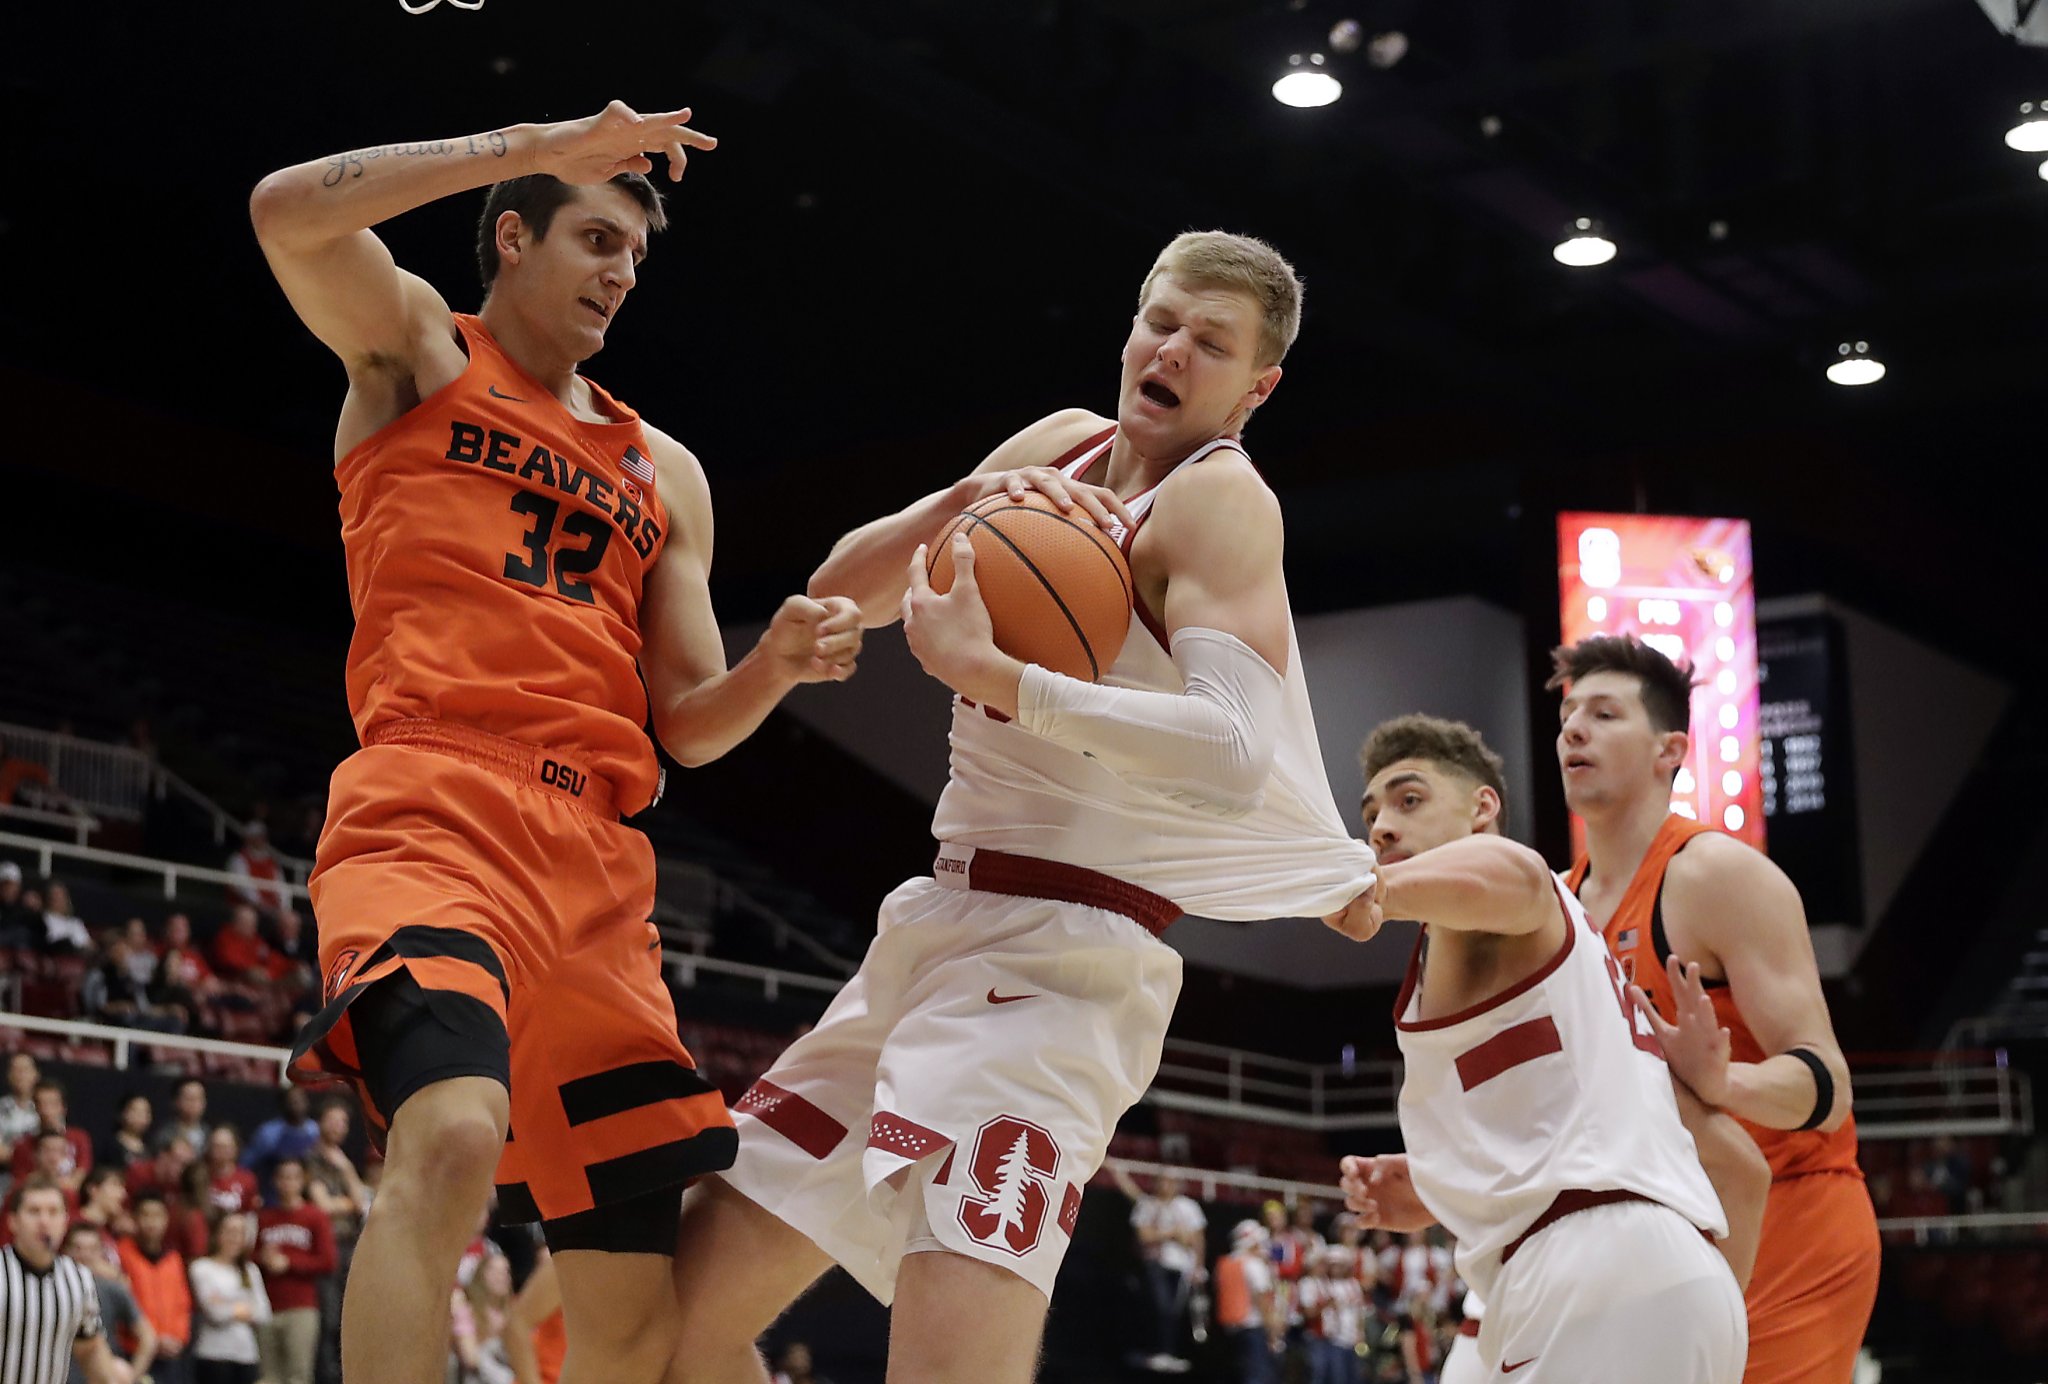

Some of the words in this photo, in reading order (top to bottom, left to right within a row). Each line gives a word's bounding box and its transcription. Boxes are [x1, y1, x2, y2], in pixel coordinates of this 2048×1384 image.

[465, 131, 507, 158] 1:9
[445, 420, 661, 560] BEAVERS
[503, 489, 614, 605] 32
[540, 759, 587, 797] OSU
